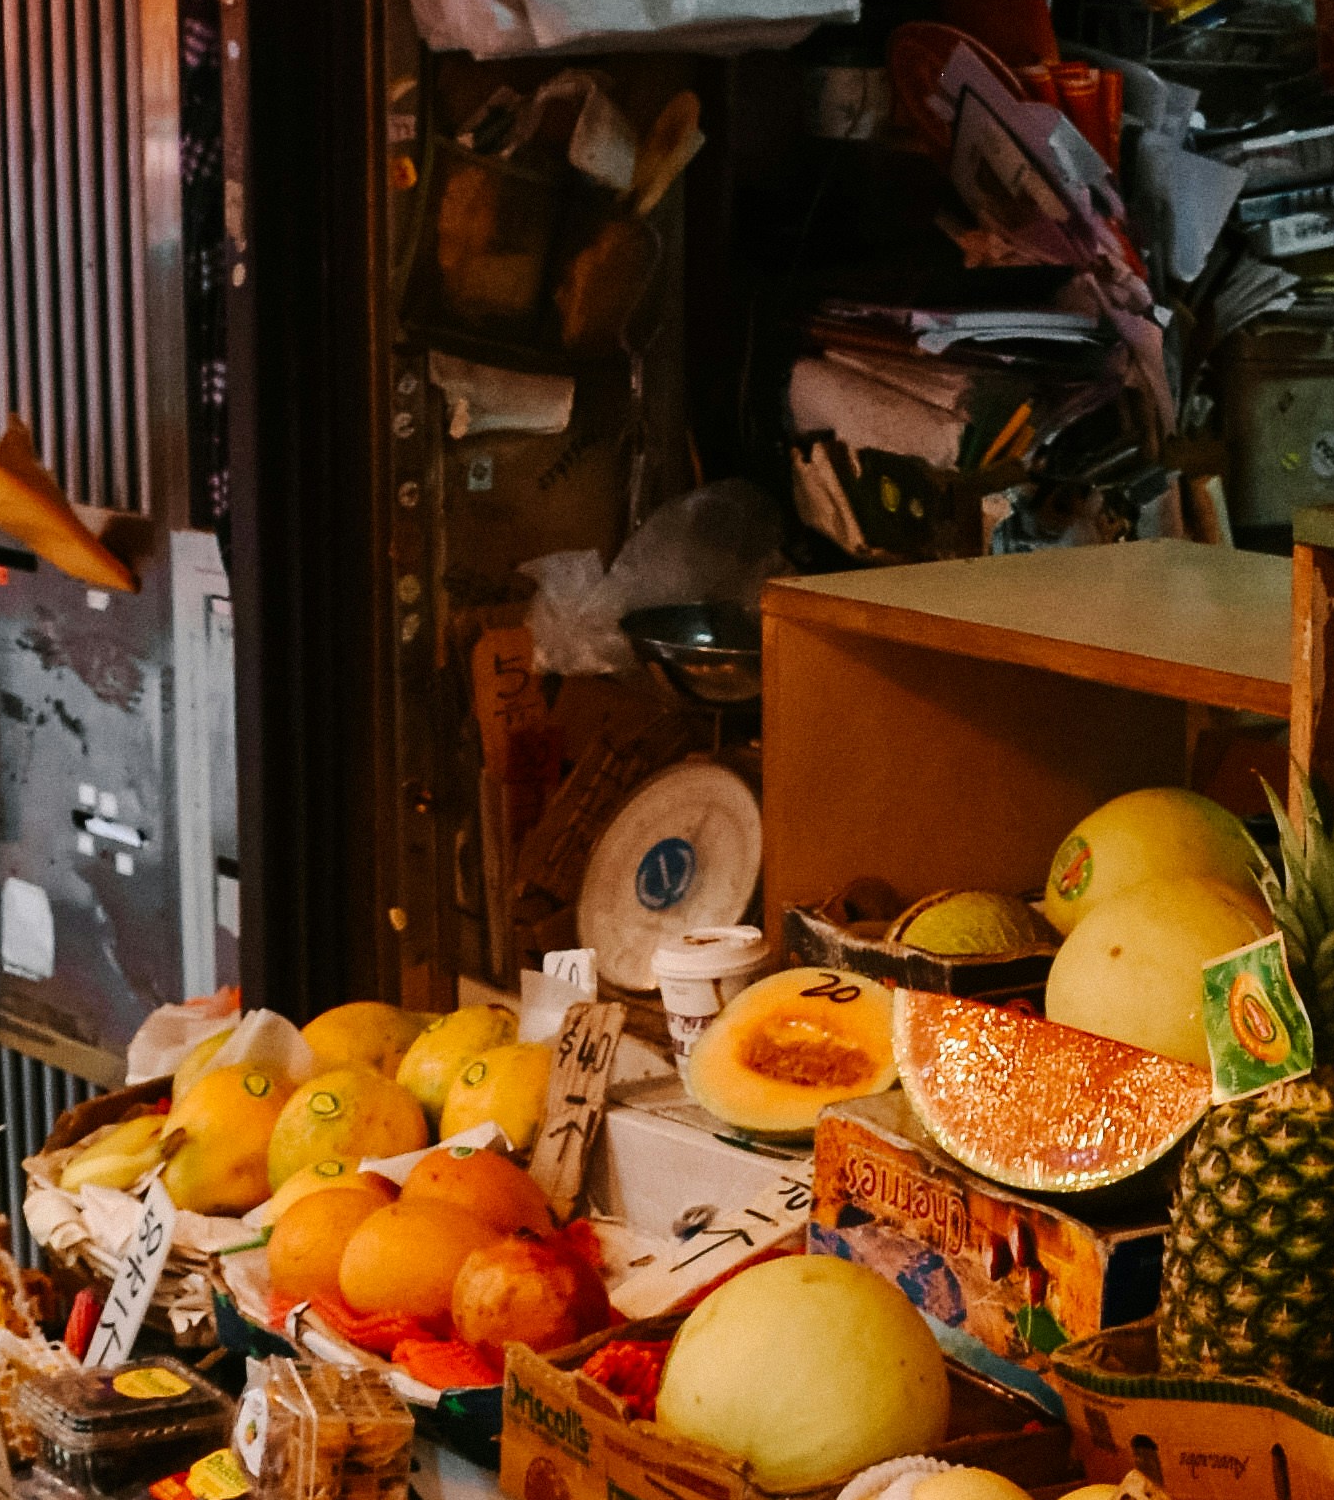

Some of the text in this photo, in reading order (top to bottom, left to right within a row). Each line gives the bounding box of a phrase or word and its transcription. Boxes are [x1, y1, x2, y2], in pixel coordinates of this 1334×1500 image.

[800, 971, 861, 1005] 20
[557, 1026, 613, 1075] $40
[846, 1156, 969, 1256] Cherries
